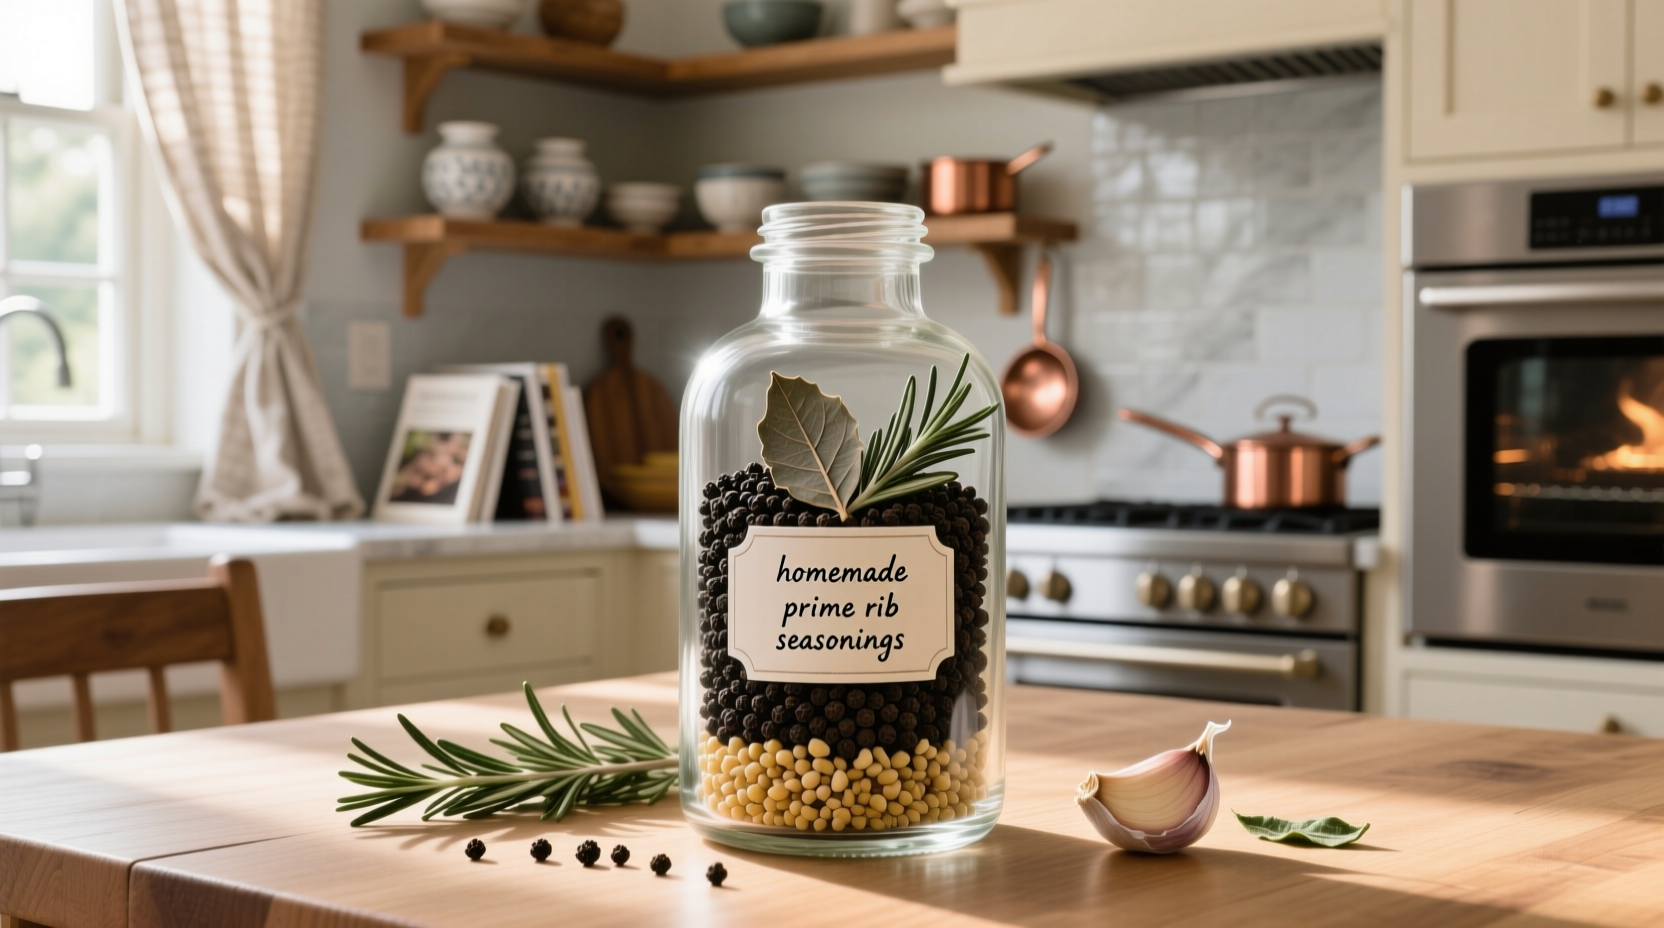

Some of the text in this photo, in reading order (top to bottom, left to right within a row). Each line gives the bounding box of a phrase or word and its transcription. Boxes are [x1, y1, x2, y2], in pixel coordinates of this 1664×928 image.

[776, 553, 909, 583] homemade
[781, 591, 899, 628] prime rib
[775, 628, 905, 663] seasonings
